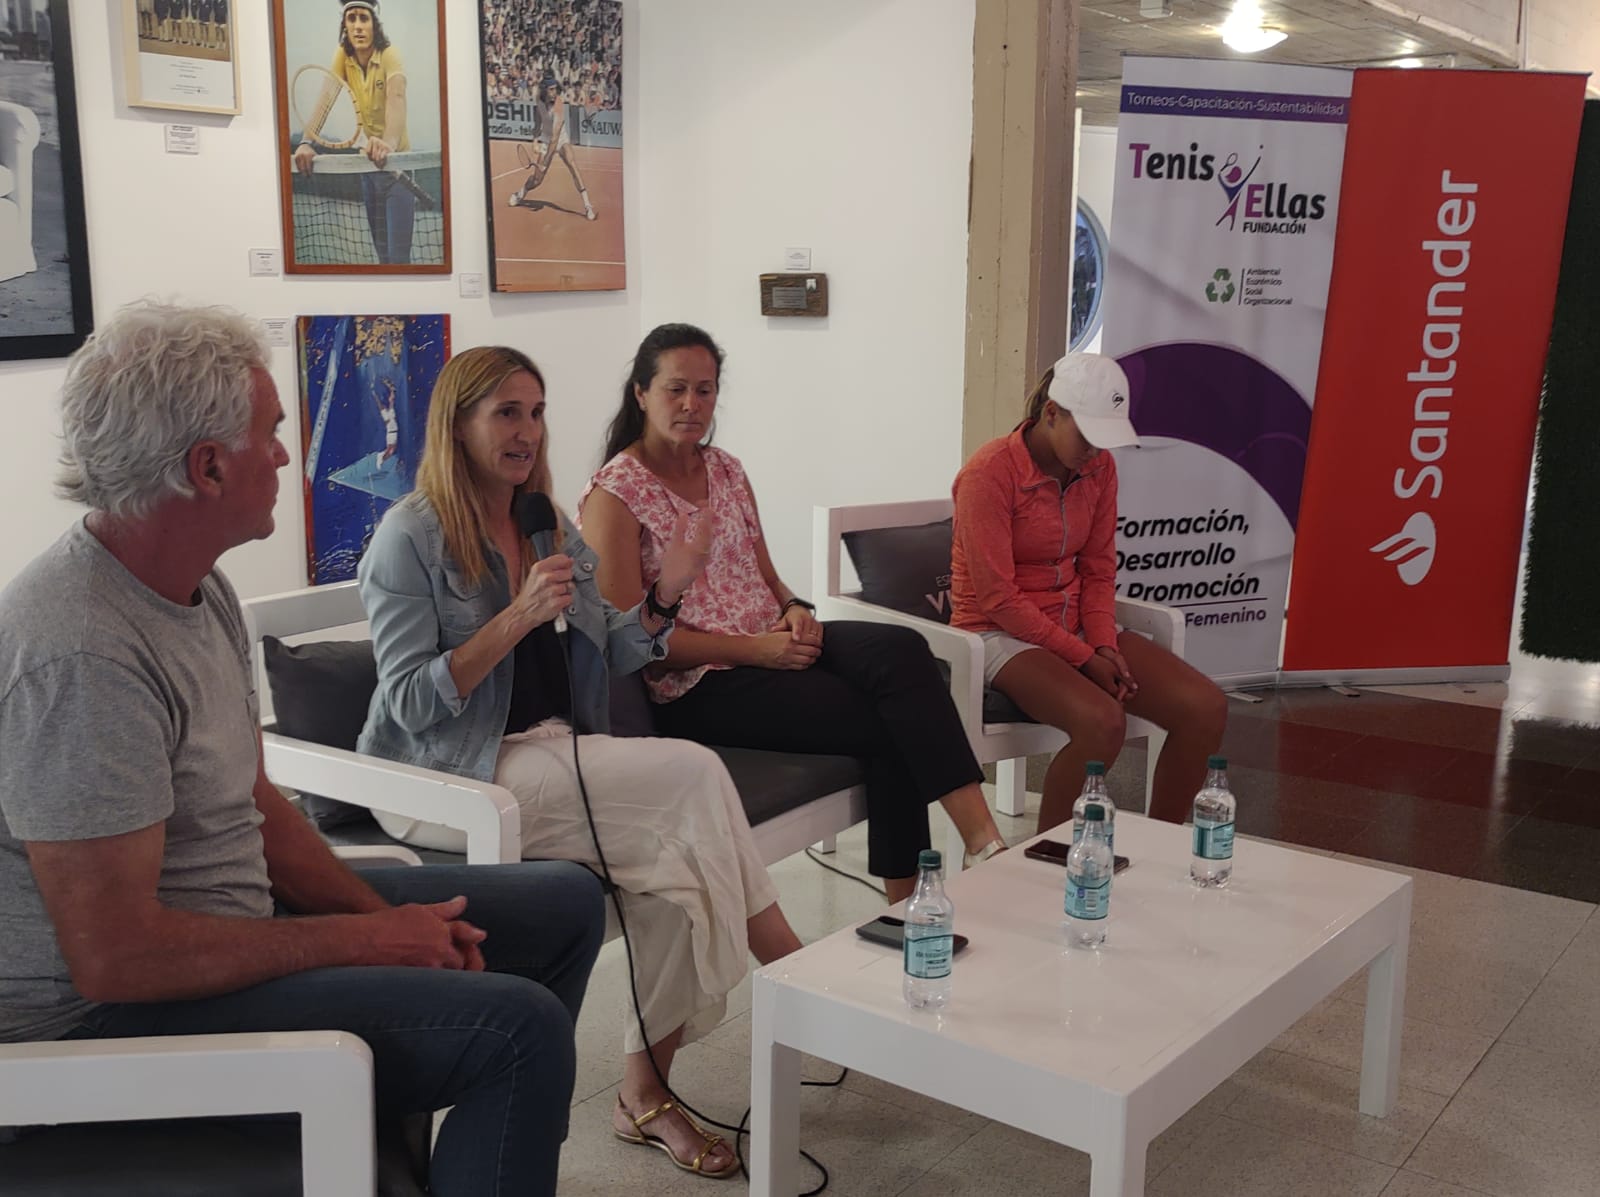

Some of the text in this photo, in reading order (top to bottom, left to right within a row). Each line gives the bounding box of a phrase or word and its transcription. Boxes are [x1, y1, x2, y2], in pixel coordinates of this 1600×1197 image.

[1127, 92, 1345, 116] Torneos-Capacitación-Sustentabilidad
[1128, 142, 1215, 181] Tenis
[1243, 183, 1327, 219] Ellas
[1243, 220, 1306, 234] FUNDACIÓN
[1394, 169, 1478, 499] Santander
[1185, 607, 1267, 627] Femenino
